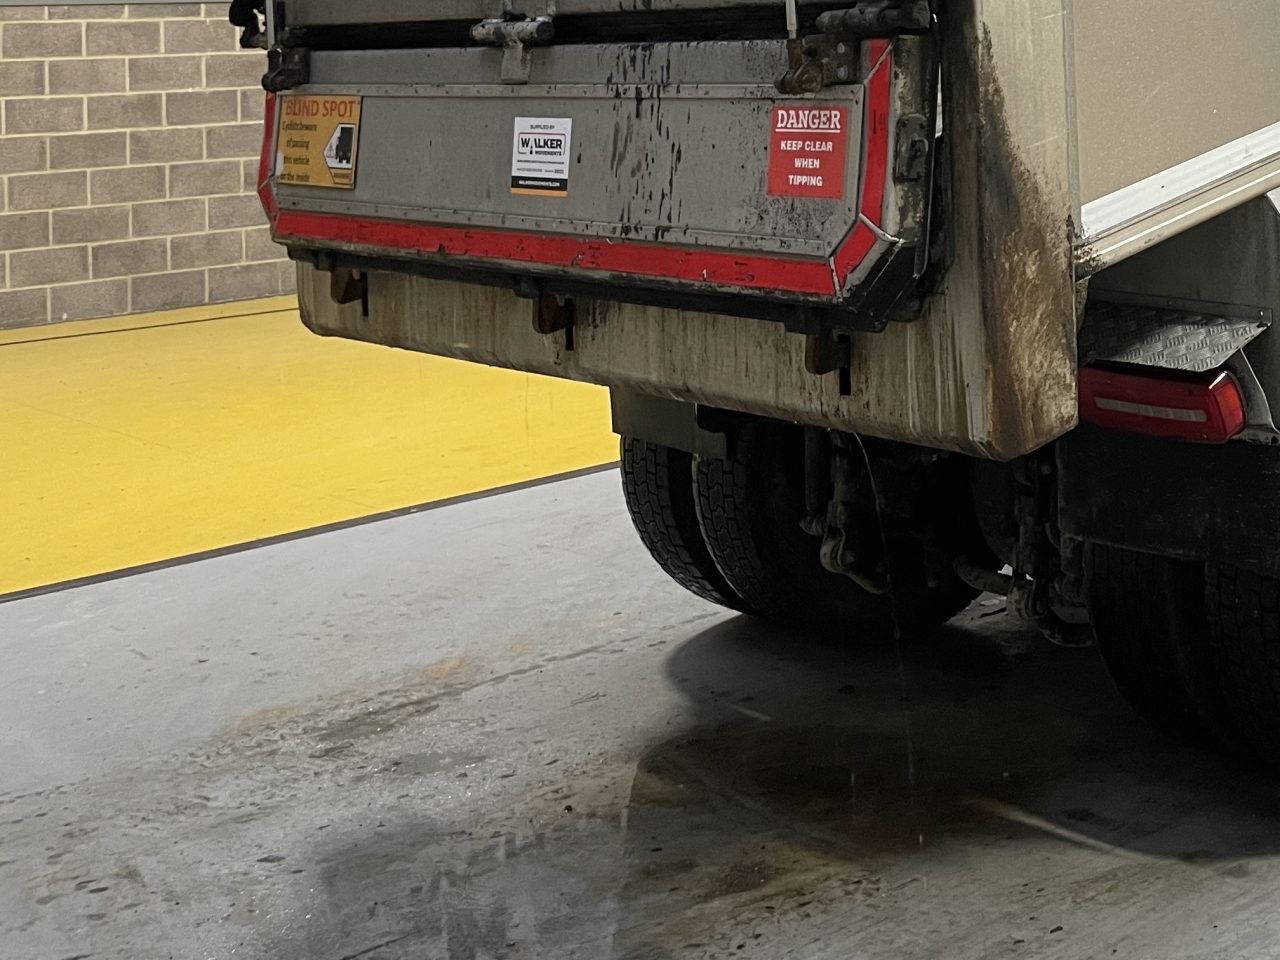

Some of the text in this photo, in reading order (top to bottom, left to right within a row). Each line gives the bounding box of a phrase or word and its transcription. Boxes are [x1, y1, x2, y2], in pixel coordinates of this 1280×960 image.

[285, 100, 356, 118] BLIND SPOT
[776, 109, 841, 129] DANGER
[521, 137, 563, 155] WALKER
[780, 140, 833, 152] KEEP CLEAR
[794, 158, 820, 169] WHEN
[788, 175, 823, 187] TIPPING
